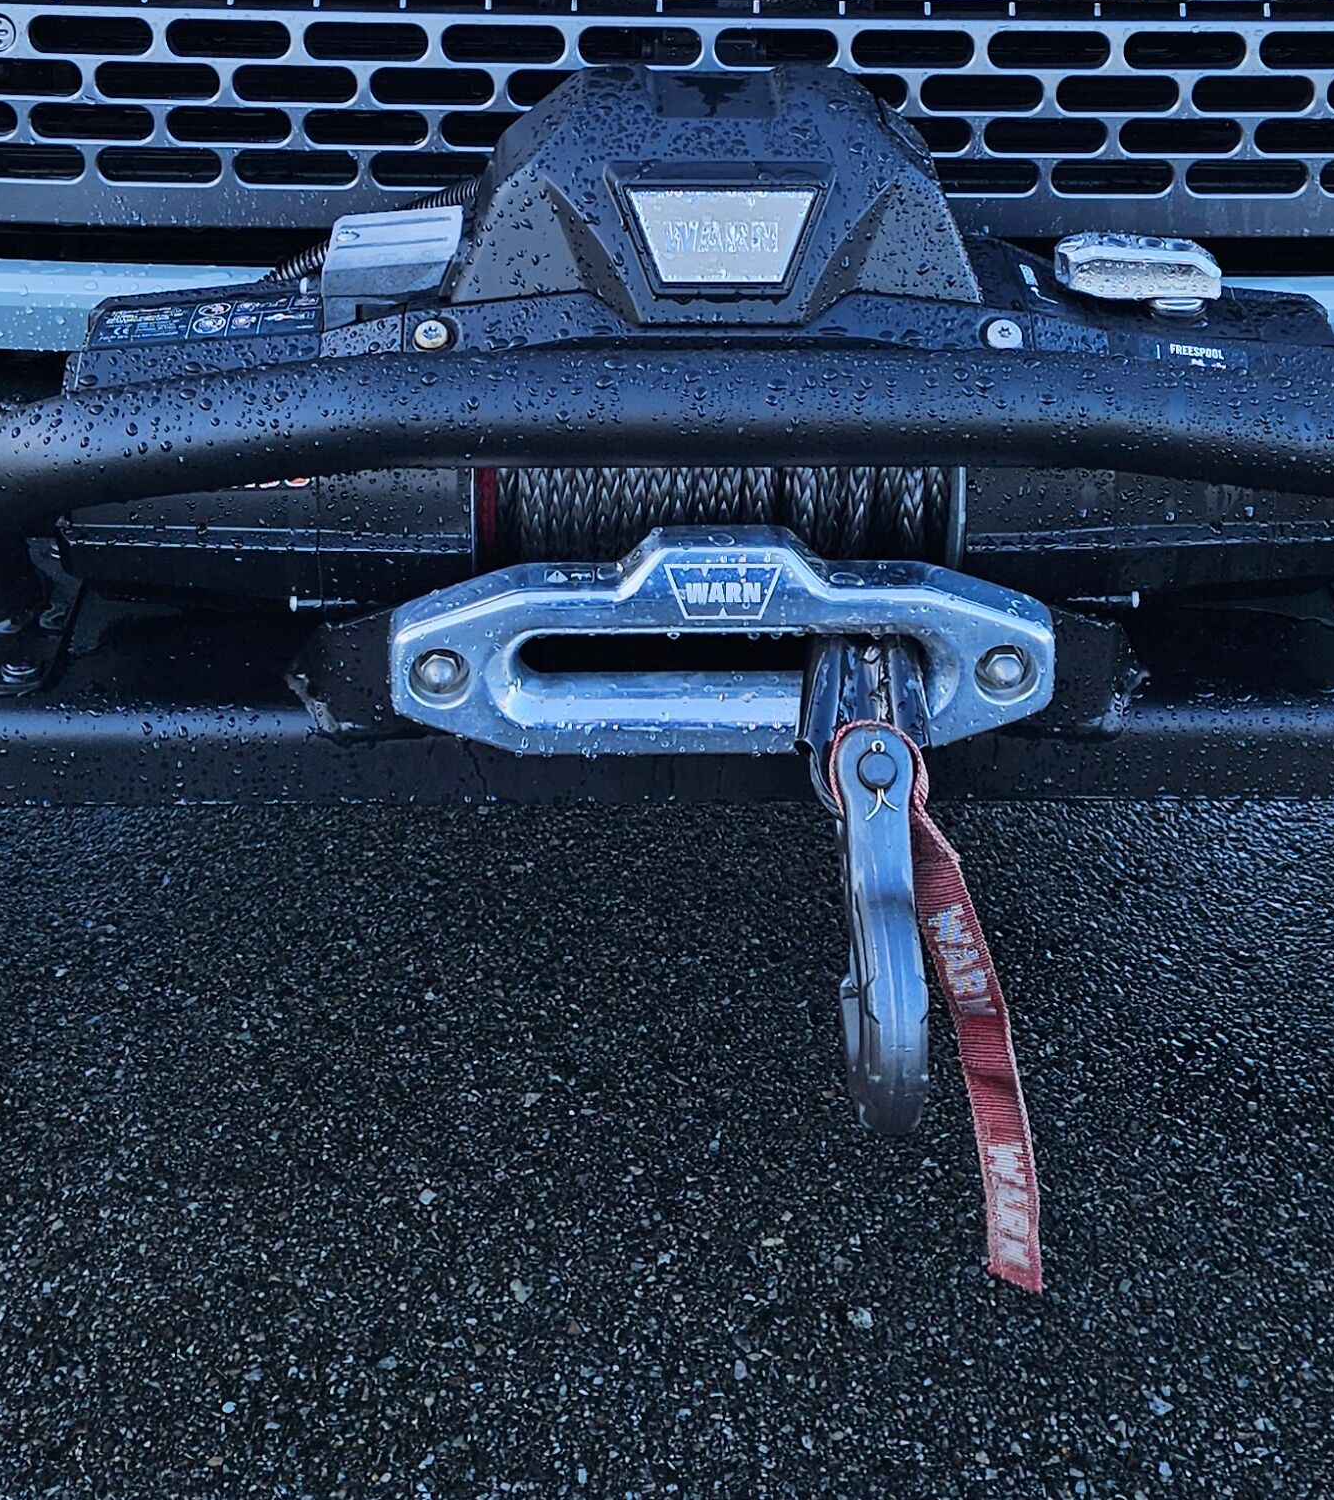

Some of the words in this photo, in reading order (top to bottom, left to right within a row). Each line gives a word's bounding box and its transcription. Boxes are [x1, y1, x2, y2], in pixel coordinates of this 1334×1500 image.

[663, 221, 780, 252] WARN
[1169, 343, 1225, 360] FREESPOOL
[686, 581, 762, 603] WARN
